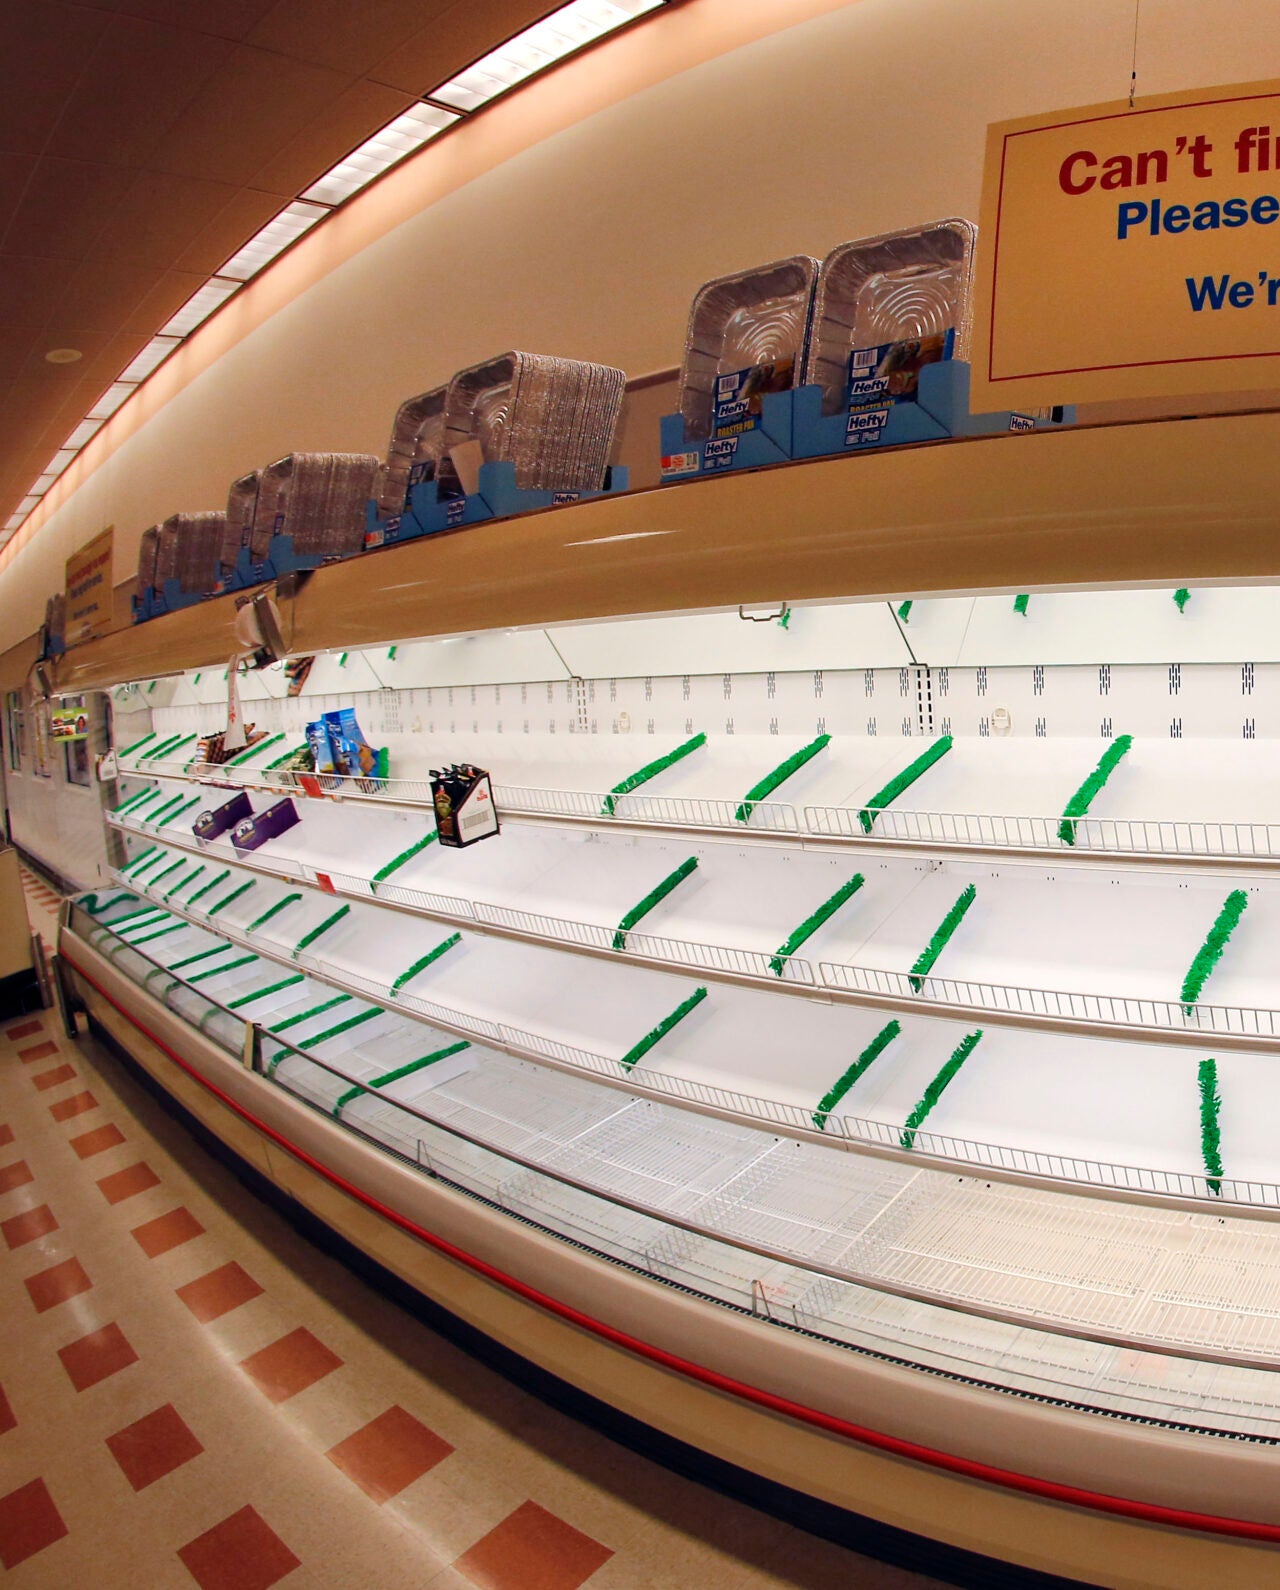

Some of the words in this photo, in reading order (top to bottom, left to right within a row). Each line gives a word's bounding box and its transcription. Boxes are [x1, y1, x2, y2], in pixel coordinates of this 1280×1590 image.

[1058, 134, 1213, 196] Can't
[1117, 195, 1280, 240] Please
[854, 379, 888, 393] Hefty
[720, 401, 748, 416] Hefty
[850, 414, 885, 429] Hefty
[706, 441, 737, 455] Hefty
